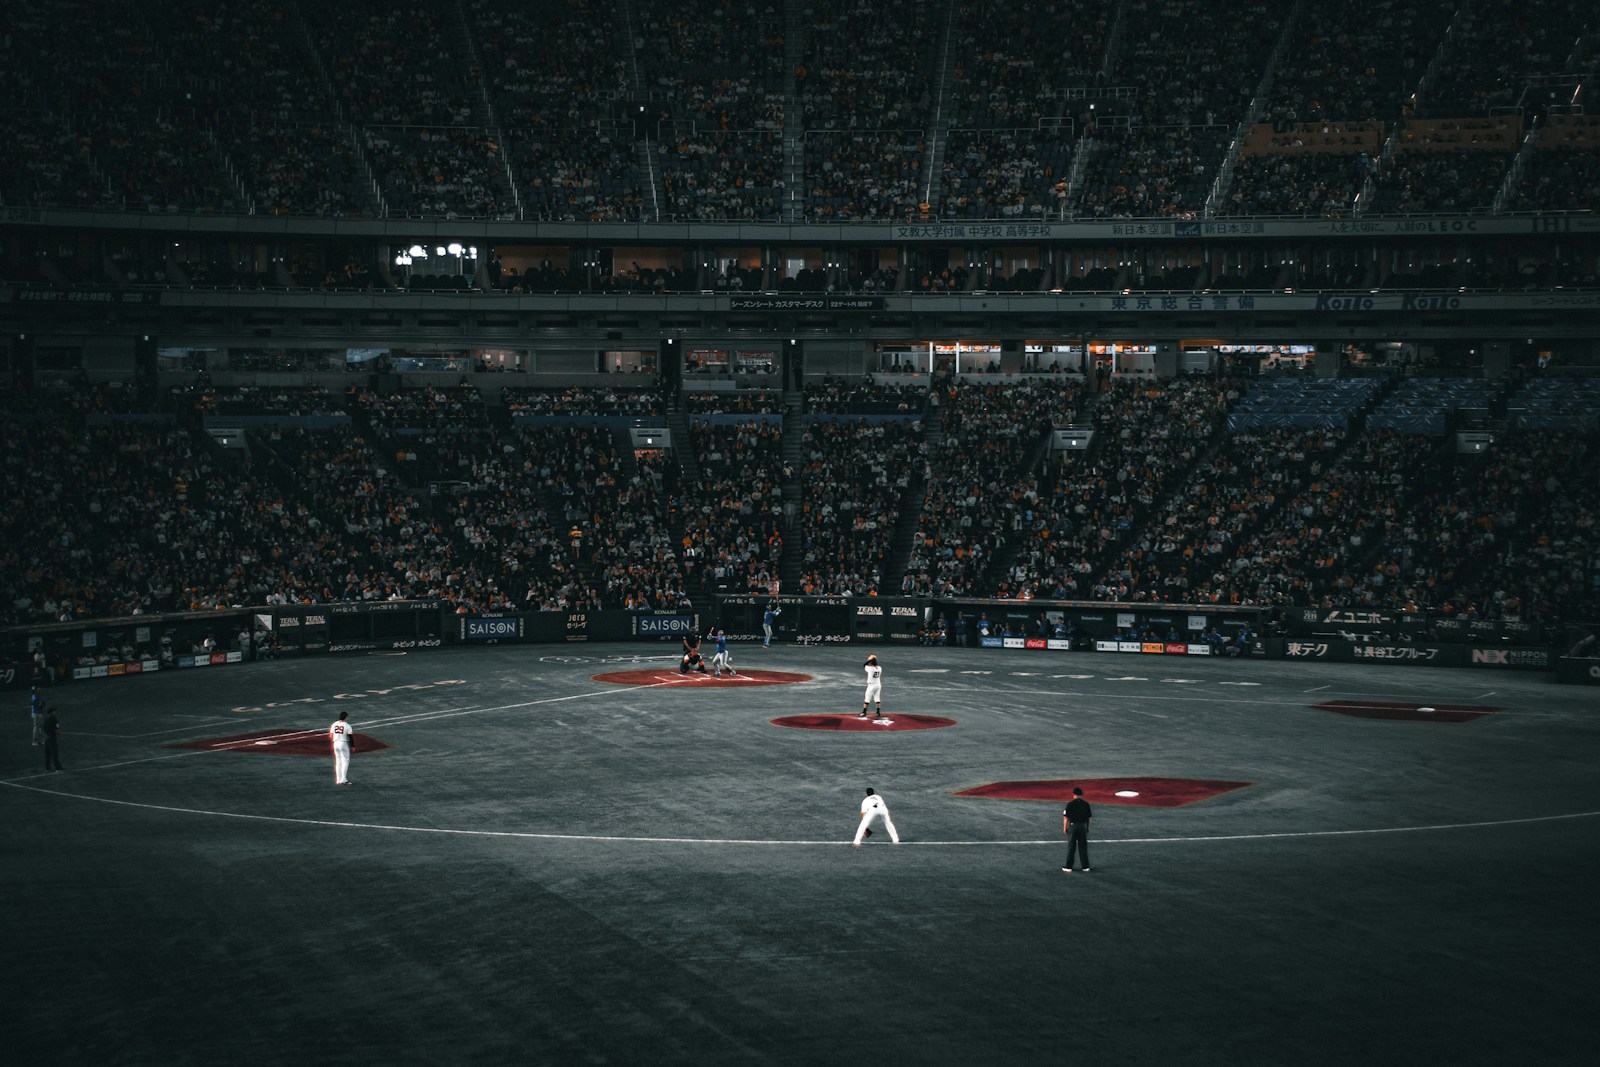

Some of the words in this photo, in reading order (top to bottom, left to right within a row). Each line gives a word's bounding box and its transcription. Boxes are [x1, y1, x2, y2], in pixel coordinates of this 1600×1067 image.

[897, 226, 964, 238] 文教大学付属
[969, 226, 1002, 238] 中学校
[1006, 225, 1051, 237] 高等学校
[731, 300, 774, 309] シーズンシート
[775, 300, 824, 308] カスタマーデスク
[1111, 296, 1255, 310] 東京総合警備
[1343, 611, 1391, 624] ユニホー
[469, 622, 516, 634] SAISON
[641, 619, 690, 631] SAISON
[1286, 642, 1329, 656] 東テク
[1363, 645, 1439, 660] 長谷工グループ
[1509, 650, 1548, 659] NIPPON
[334, 725, 345, 734] 29
